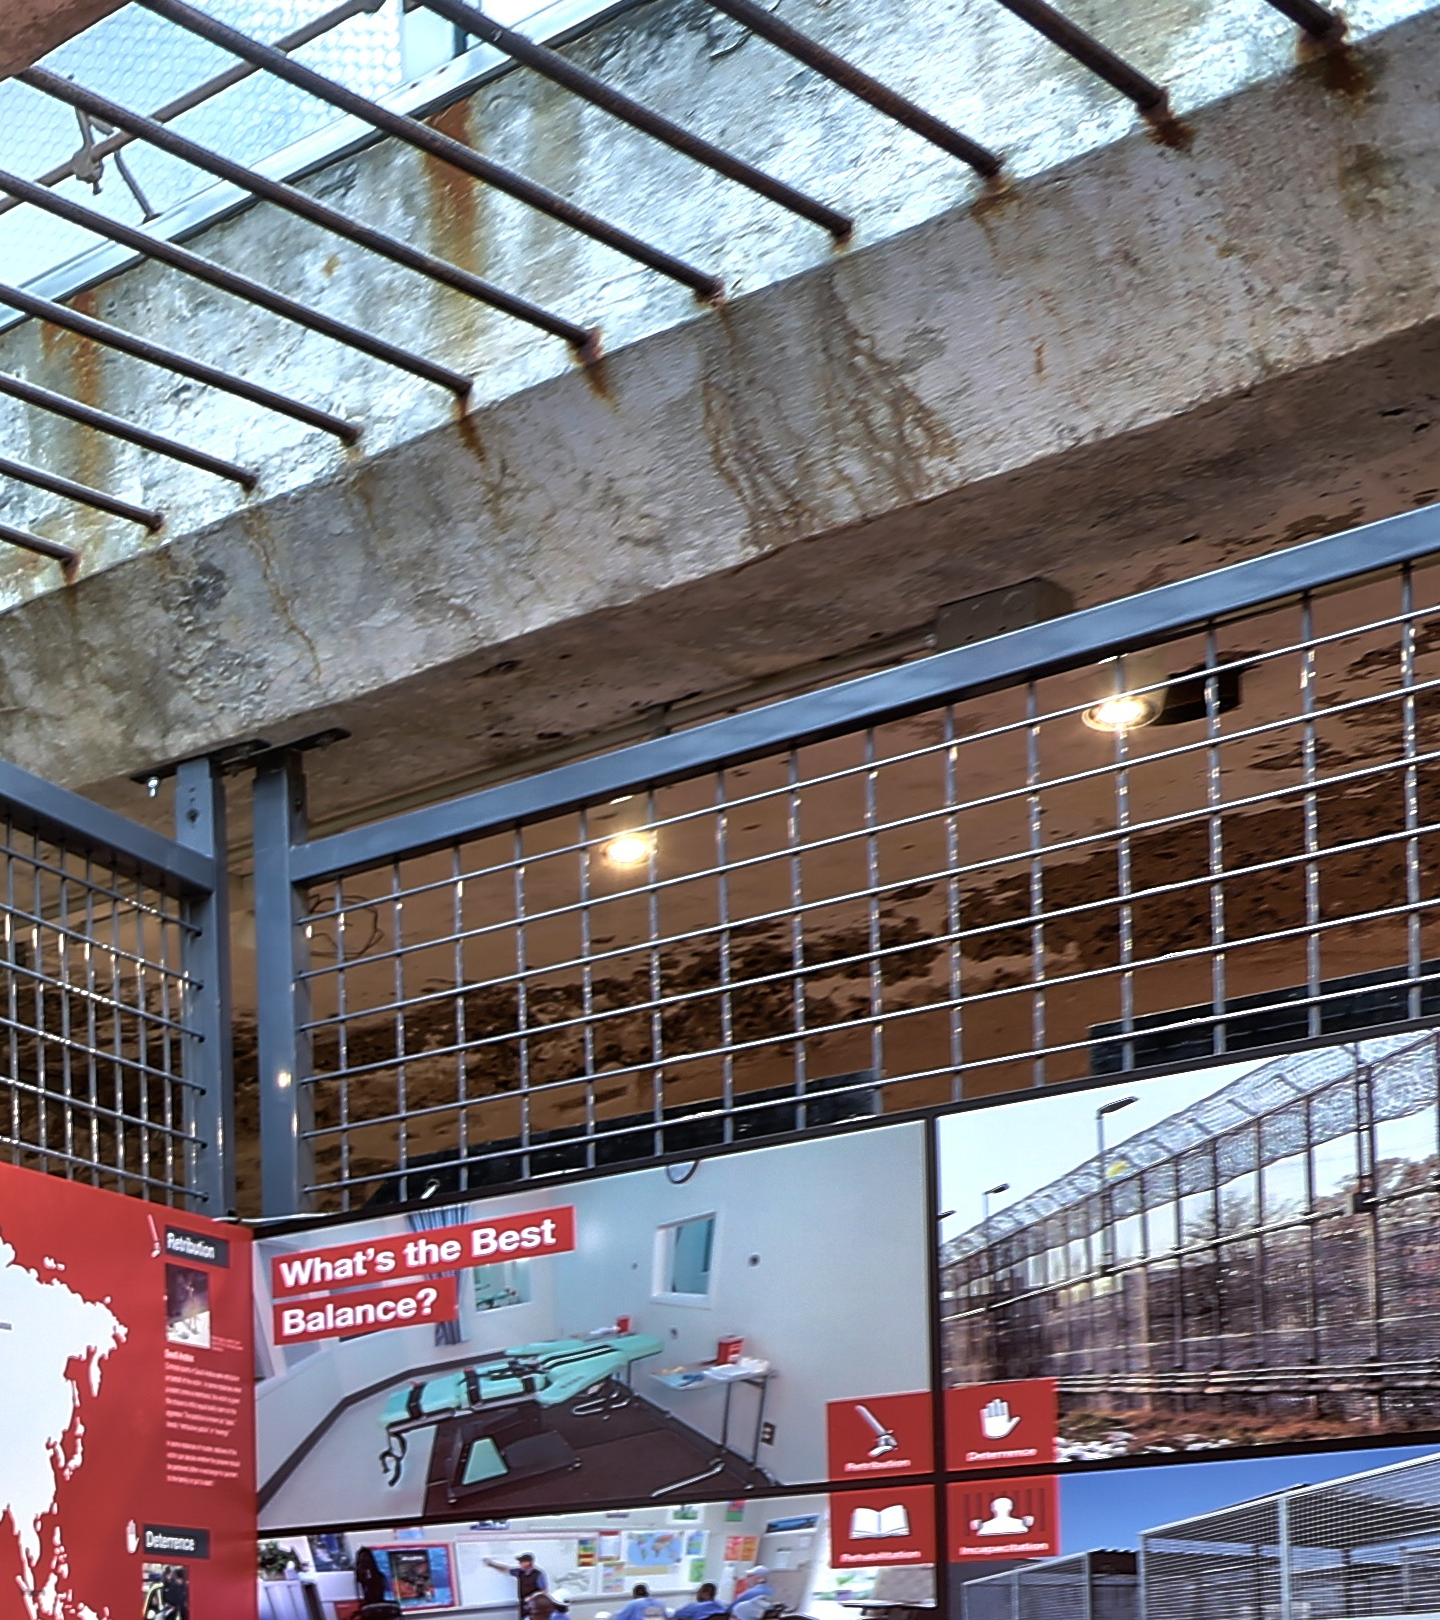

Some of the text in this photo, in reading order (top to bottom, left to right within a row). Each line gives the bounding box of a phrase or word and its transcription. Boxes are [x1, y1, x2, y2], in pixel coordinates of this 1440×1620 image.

[280, 1219, 557, 1287] What's the Best
[283, 1288, 437, 1335] Balance?
[145, 1530, 195, 1551] Deterrence
